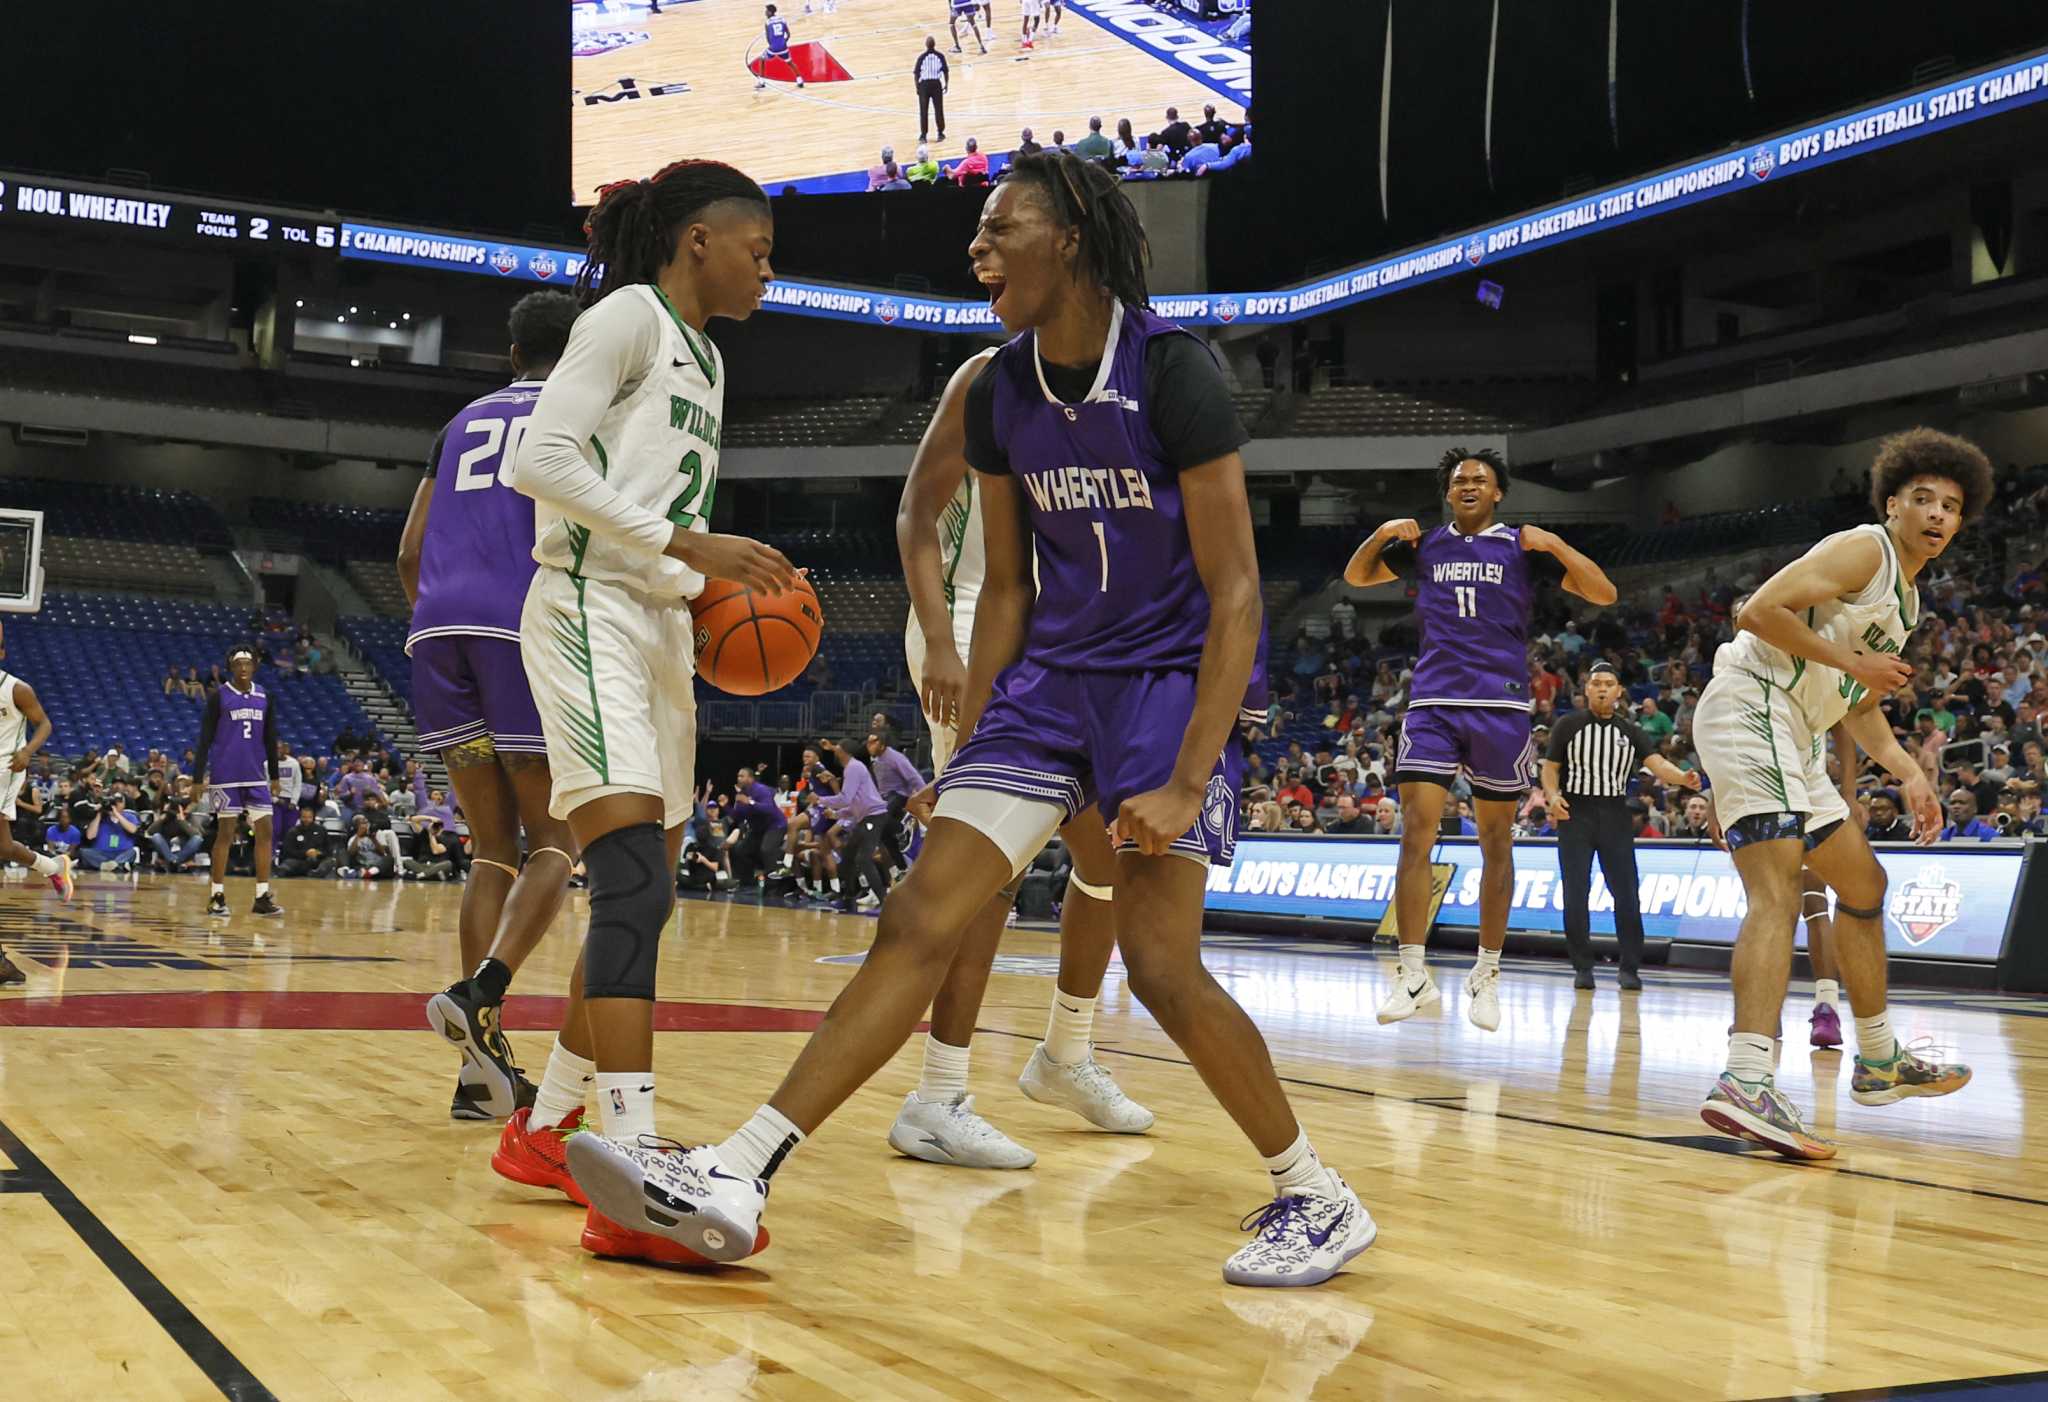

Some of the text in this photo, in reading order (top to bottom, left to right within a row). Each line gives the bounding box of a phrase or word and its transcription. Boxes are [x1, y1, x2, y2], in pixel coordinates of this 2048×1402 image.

[773, 23, 783, 36] 12
[1779, 136, 1820, 165] BOYS
[1823, 102, 1925, 152] BASKETBALL
[1928, 85, 1976, 120] STATE
[17, 186, 66, 216] HOU.
[69, 193, 171, 228] WHEATLEY
[1488, 157, 1746, 253] BOYS BASKETBALL STATE CHAMPIONSHIPS
[197, 223, 238, 238] FOULS
[200, 212, 235, 226] TEAM
[249, 217, 269, 240] 2
[281, 225, 335, 248] TOL 5
[354, 230, 486, 265] CHAMPIONSHIPS
[1245, 244, 1463, 315] BOYS BASKETBALL STATE CHAMPIONSHIPS
[903, 302, 942, 324] BOYS
[1092, 521, 1109, 593] 1
[1433, 562, 1504, 585] WHEATLEY
[1455, 586, 1477, 618] 11
[243, 720, 252, 739] 2
[1233, 861, 1300, 896] BOYS
